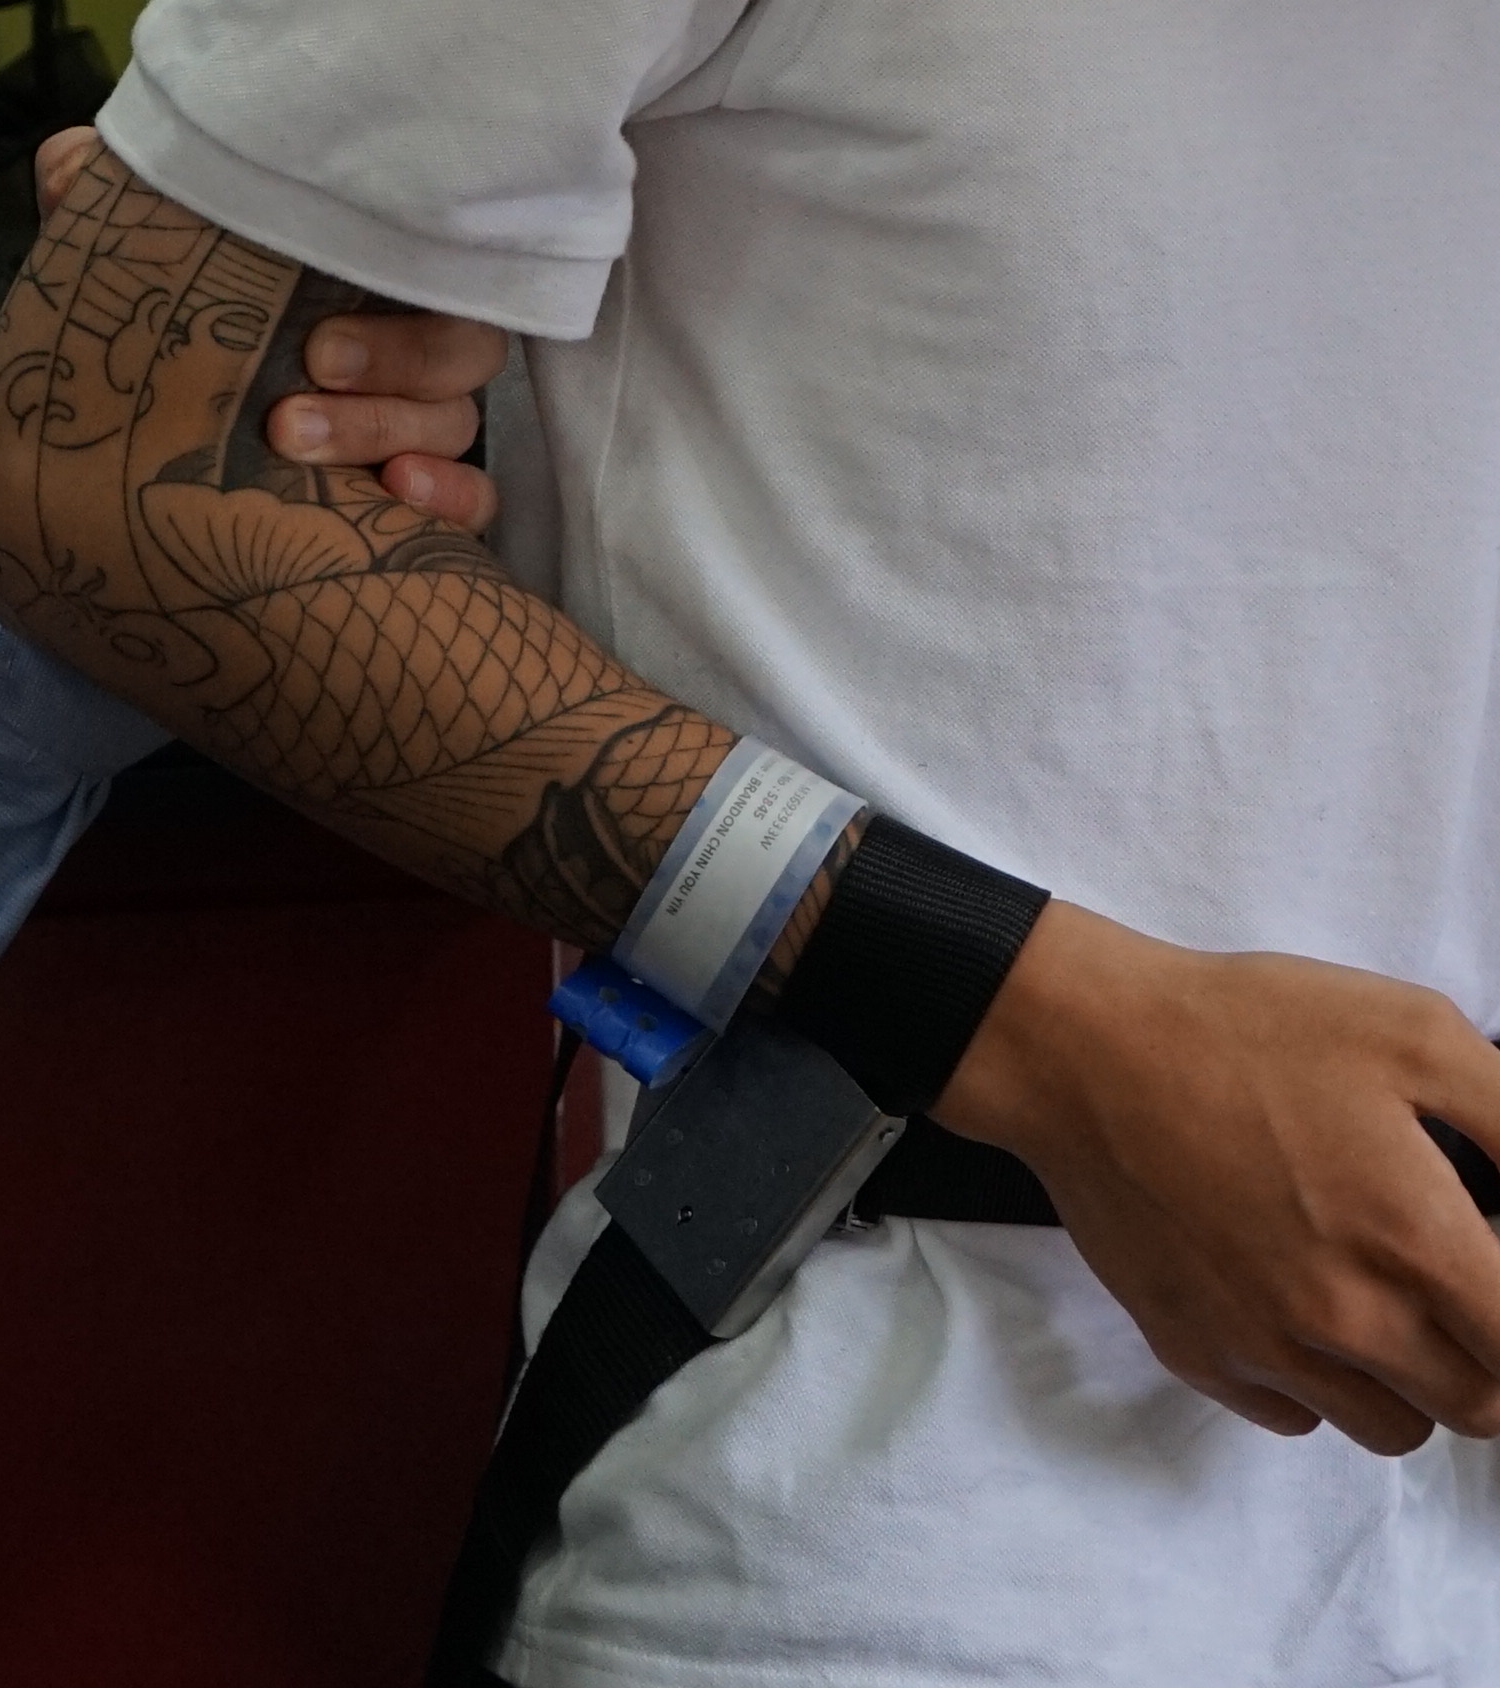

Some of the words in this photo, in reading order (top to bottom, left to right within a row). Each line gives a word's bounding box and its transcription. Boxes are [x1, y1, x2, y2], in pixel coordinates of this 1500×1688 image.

[716, 776, 762, 838] BRANDON
[754, 791, 779, 820] 5845
[695, 838, 721, 870] CHIN
[679, 869, 701, 896] YOU
[666, 892, 684, 916] YIN
